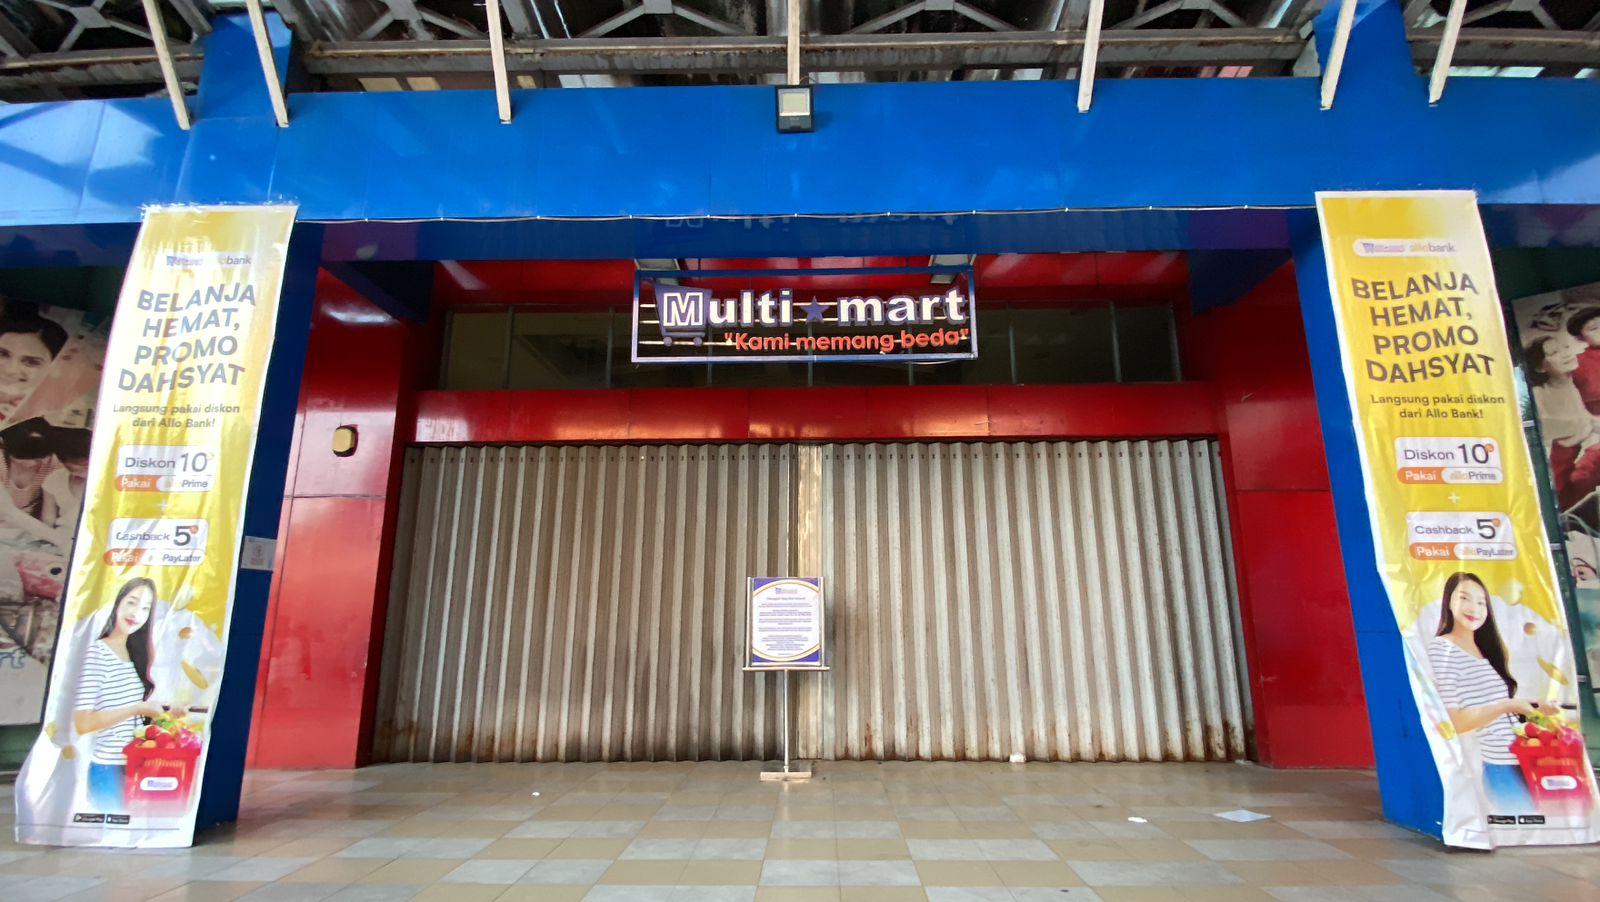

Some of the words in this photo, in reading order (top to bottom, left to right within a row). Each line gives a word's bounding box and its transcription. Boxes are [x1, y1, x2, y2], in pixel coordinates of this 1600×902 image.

[1351, 271, 1479, 300] BELANJA
[137, 282, 256, 312] BELANJA
[663, 287, 793, 328] Multi
[836, 289, 967, 326] mart
[1369, 297, 1473, 327] HEMAT,
[142, 308, 240, 338] HEMAT,
[796, 333, 894, 352] memang
[1373, 325, 1479, 355] PROMO
[134, 335, 238, 366] PROMO
[1365, 353, 1495, 383] DAHSYAT
[118, 363, 246, 393] DAHSYAT
[1371, 395, 1430, 406] Langsung
[1433, 394, 1464, 406] pakai
[1467, 394, 1505, 404] diskon
[113, 404, 168, 415] Langsung
[170, 404, 202, 415] pakai
[204, 403, 240, 414] diskon
[1400, 408, 1422, 418] dari
[1426, 408, 1448, 418] Allo
[1451, 408, 1483, 418] Bank!
[132, 417, 156, 427] dari
[158, 418, 182, 428] Allo
[185, 418, 216, 428] Bank!
[1404, 449, 1455, 460] Diskon
[124, 457, 176, 468] Diskon
[1405, 470, 1437, 480] Pakai
[121, 477, 151, 488] Pakai
[1414, 525, 1474, 535] Cashback
[116, 532, 170, 541] Cashback
[1416, 546, 1450, 557] Pakai
